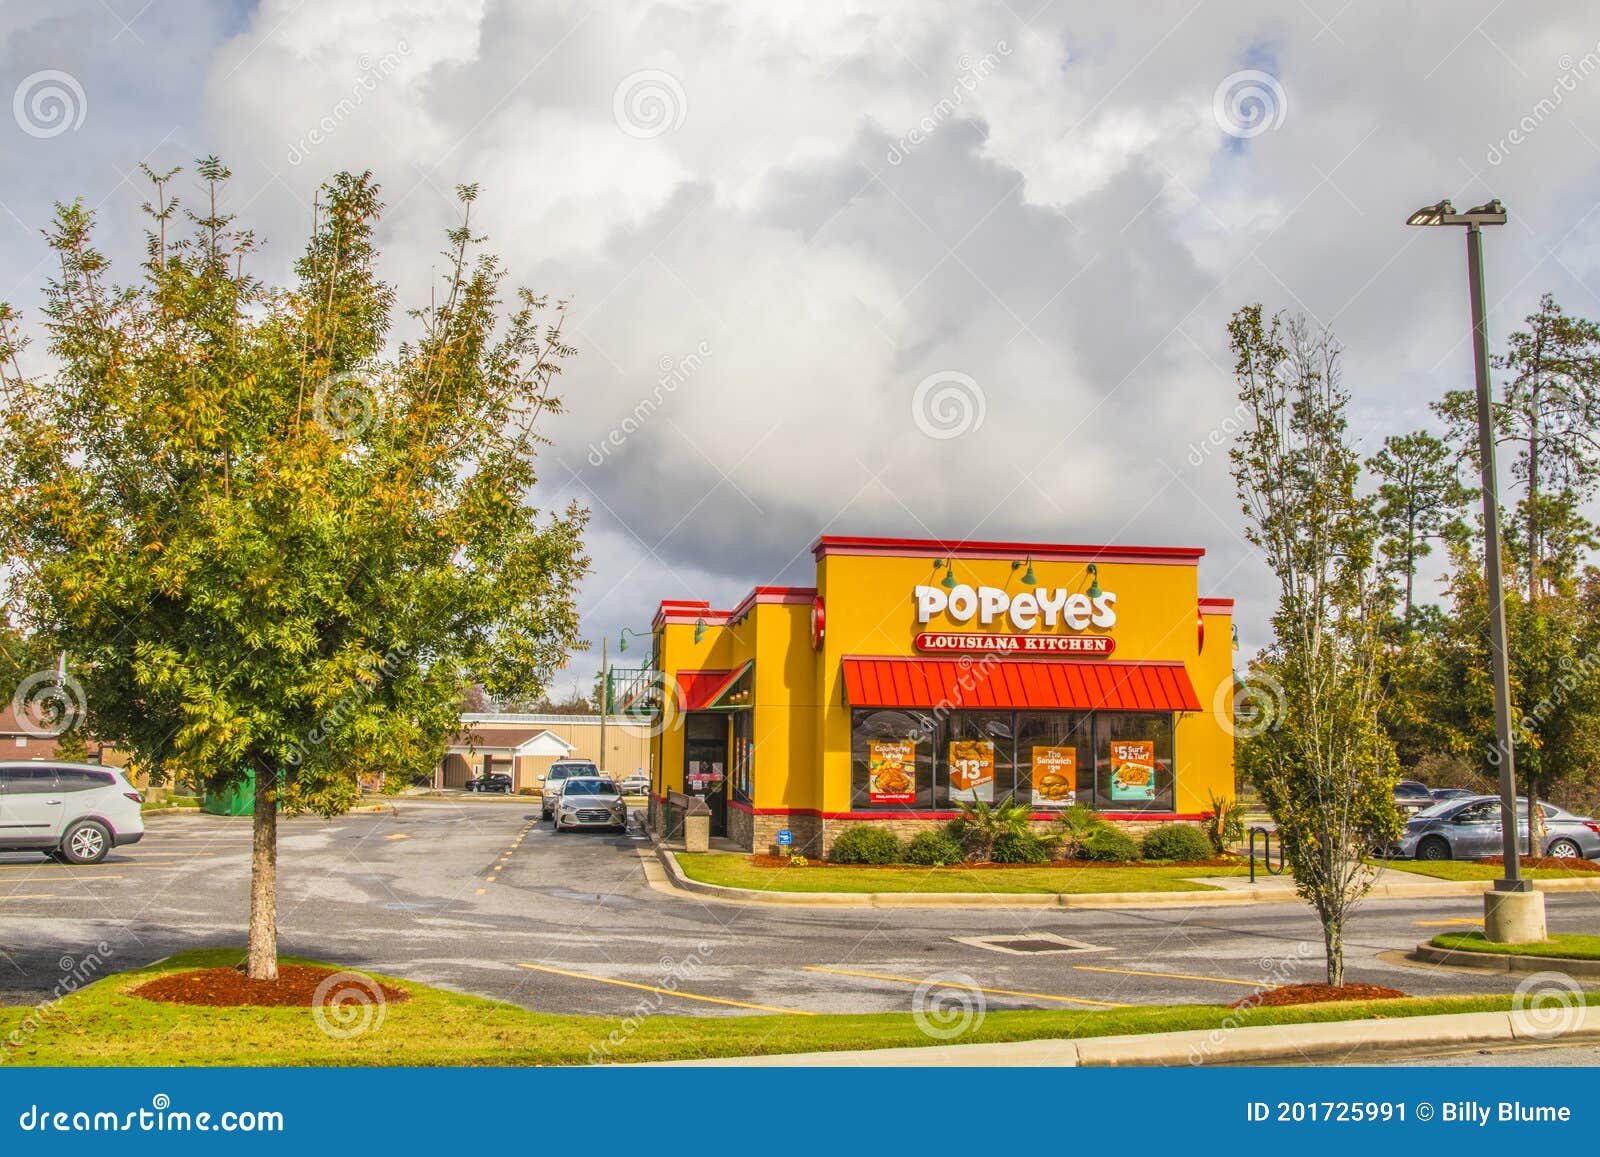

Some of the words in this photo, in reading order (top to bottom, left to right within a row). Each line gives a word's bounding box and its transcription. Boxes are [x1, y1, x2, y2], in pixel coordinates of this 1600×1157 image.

[925, 636, 1019, 650] LOUISIANA
[1025, 638, 1107, 651] KITCHEN
[1128, 745, 1144, 753] Surf
[1134, 752, 1150, 760] Turf
[1037, 756, 1072, 765] Sandwich
